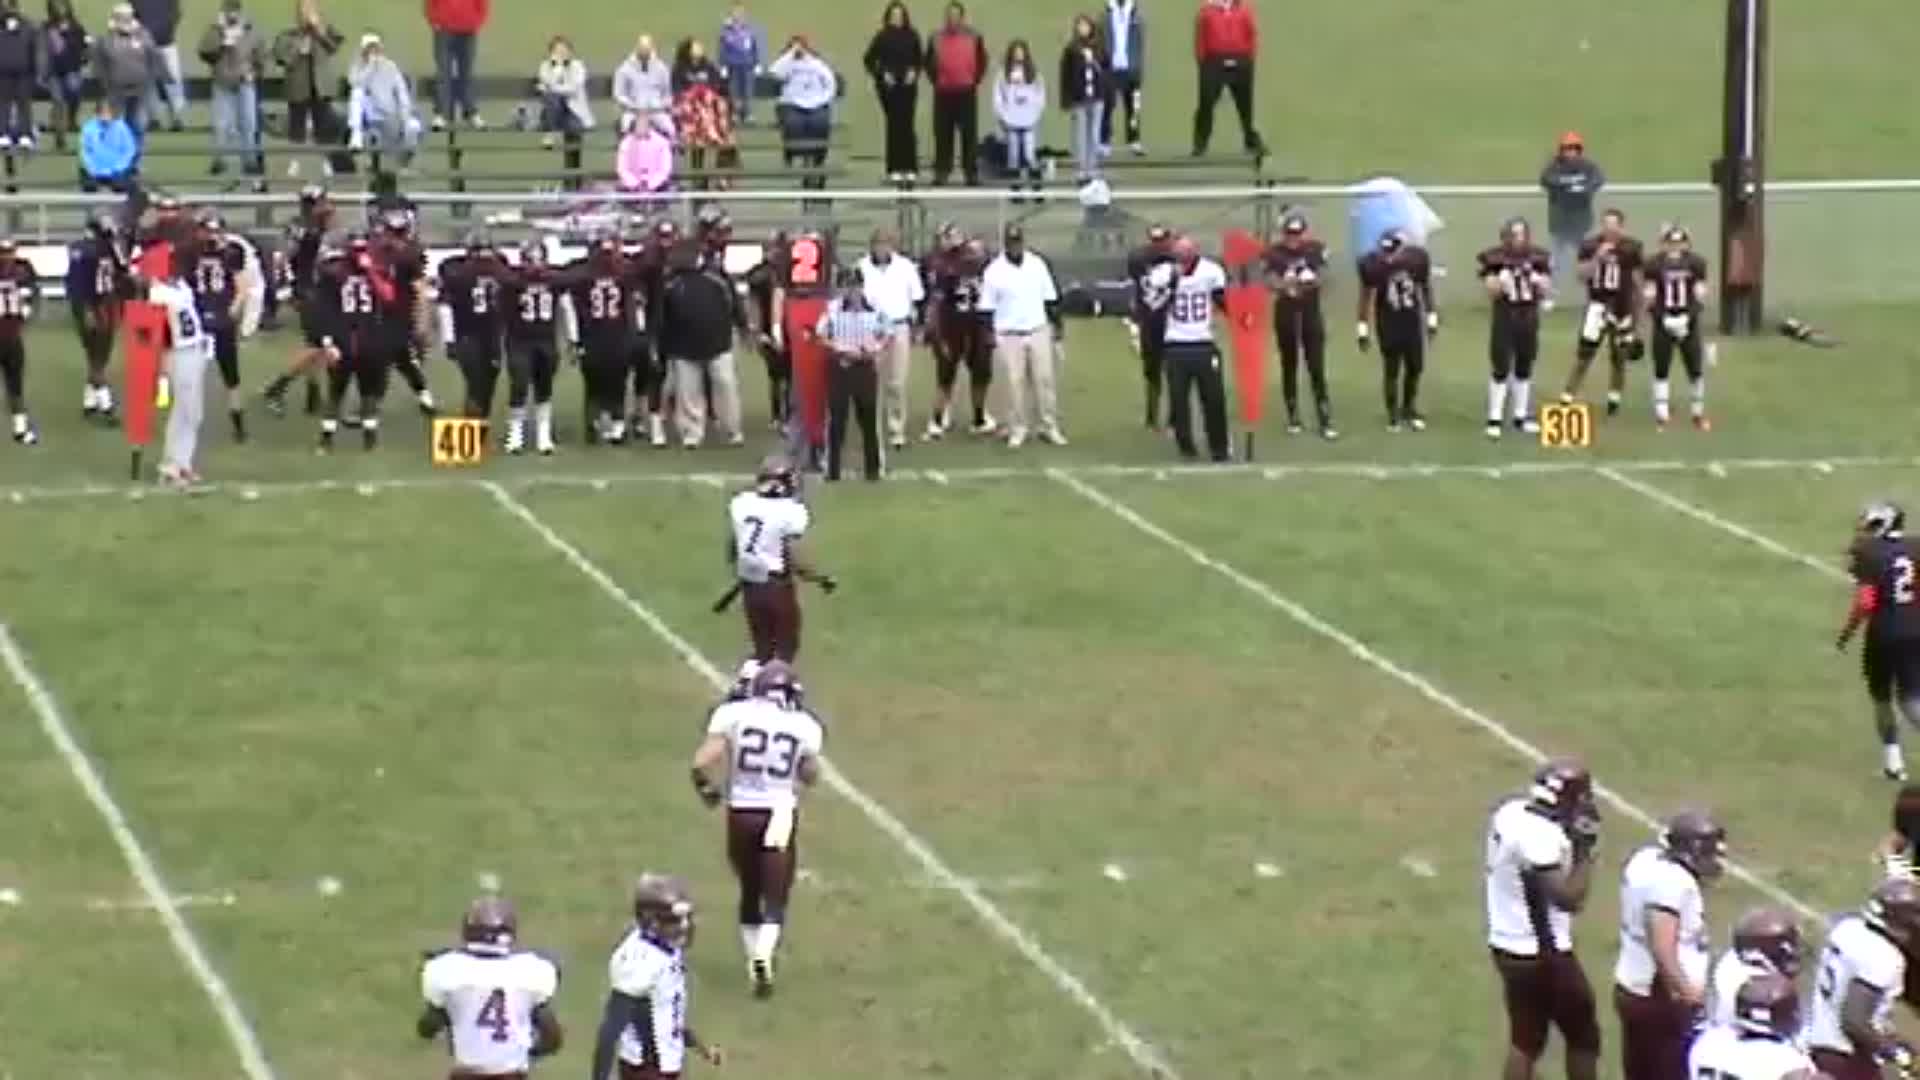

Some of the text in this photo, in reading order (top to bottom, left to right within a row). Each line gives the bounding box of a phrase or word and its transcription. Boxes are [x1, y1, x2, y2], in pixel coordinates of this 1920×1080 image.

[790, 239, 822, 283] 2
[340, 285, 373, 314] 65
[437, 424, 475, 459] 40
[1547, 411, 1585, 446] 30
[739, 728, 799, 780] 23
[476, 987, 511, 1043] 4
